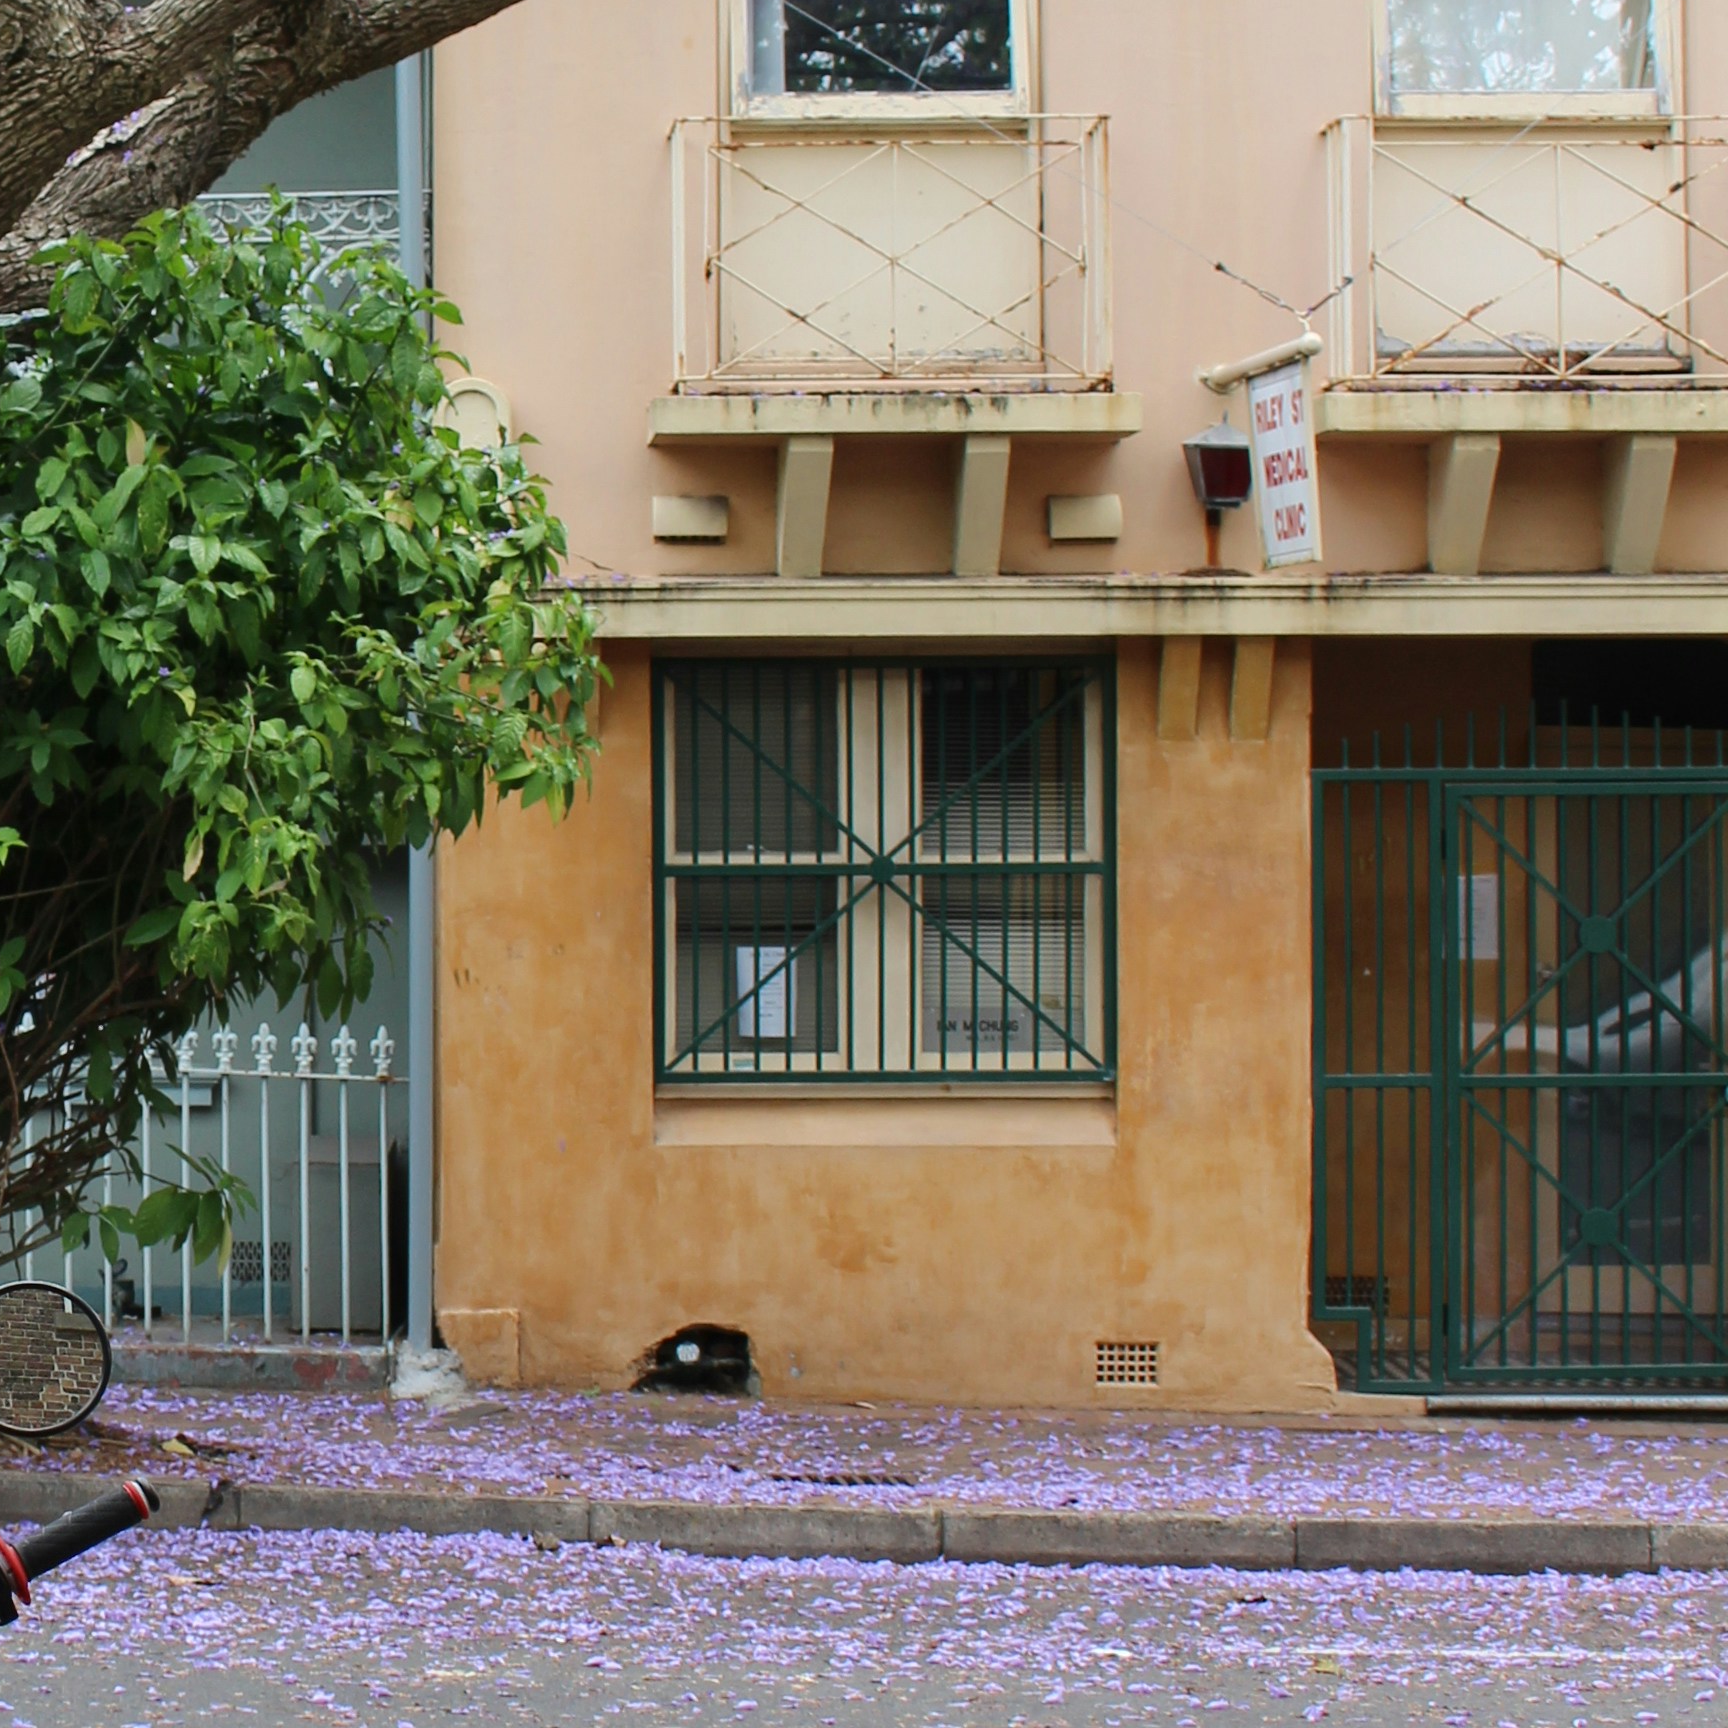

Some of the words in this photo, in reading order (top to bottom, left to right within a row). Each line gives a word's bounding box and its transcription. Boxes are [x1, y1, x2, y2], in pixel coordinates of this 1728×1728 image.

[1255, 393, 1283, 435] RILEY
[1291, 388, 1304, 425] ST
[1263, 446, 1308, 489] MEDICAL
[1274, 502, 1306, 542] CLINIC
